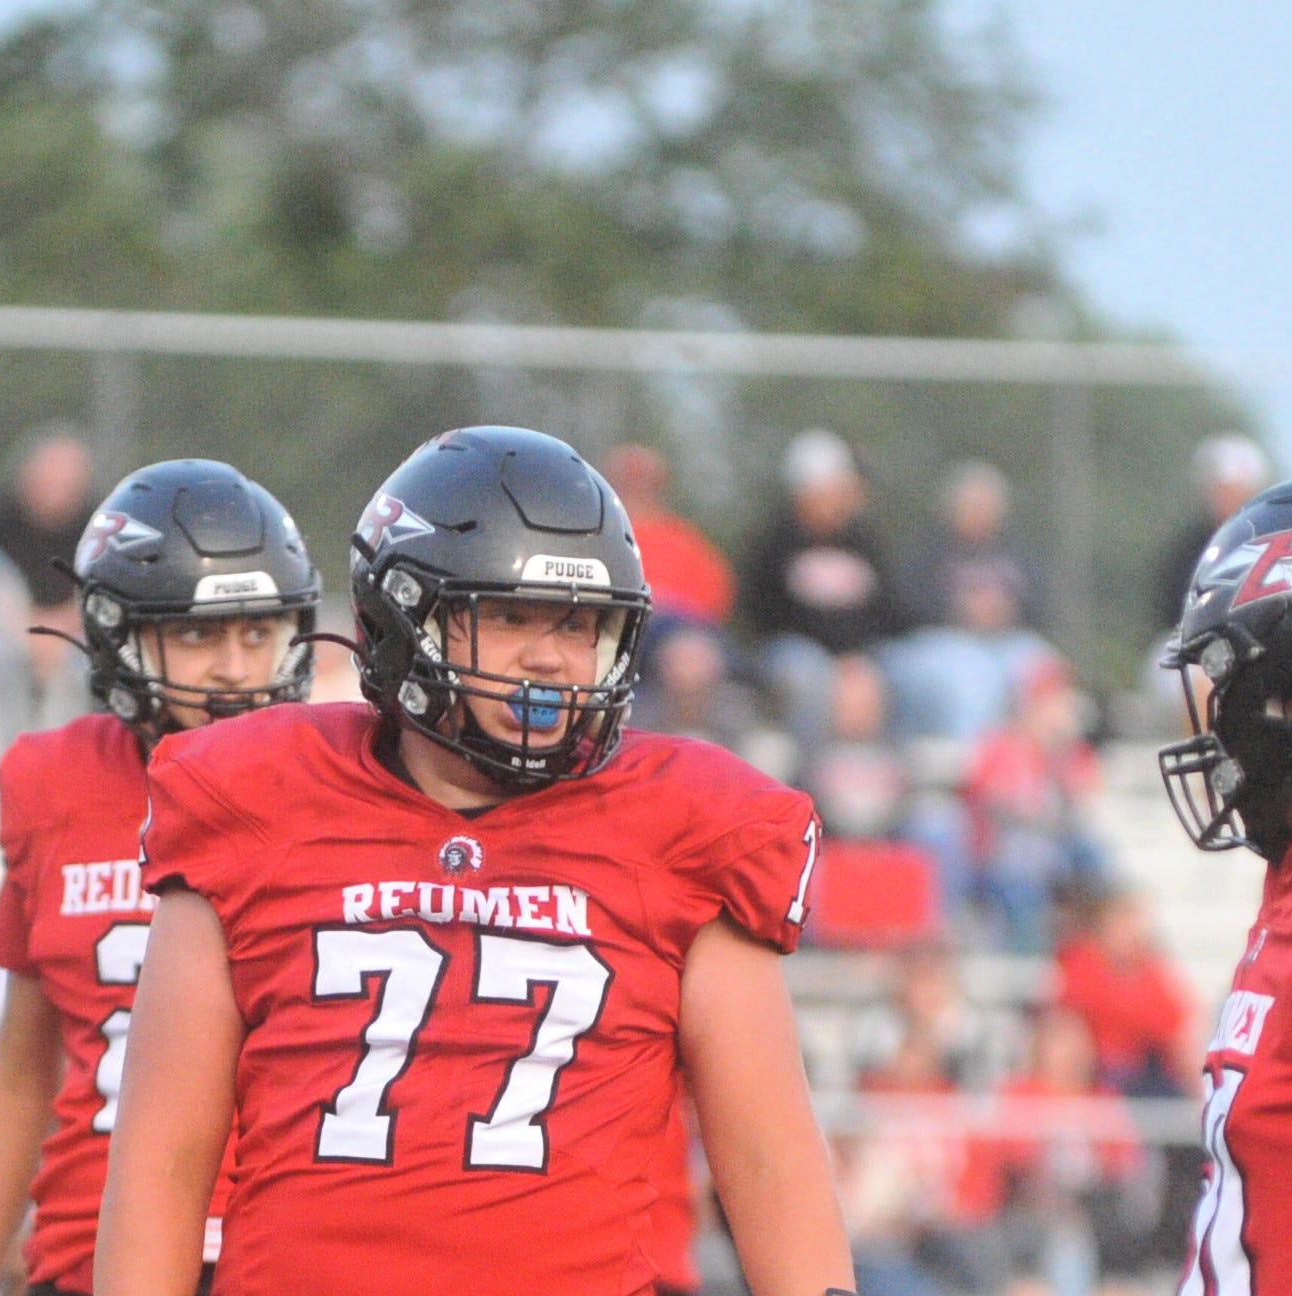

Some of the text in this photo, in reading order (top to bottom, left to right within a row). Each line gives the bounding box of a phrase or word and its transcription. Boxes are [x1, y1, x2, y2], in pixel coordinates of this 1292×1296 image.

[544, 561, 595, 579] PUDGE
[341, 880, 593, 937] REDMEN
[311, 922, 616, 1176] 77
